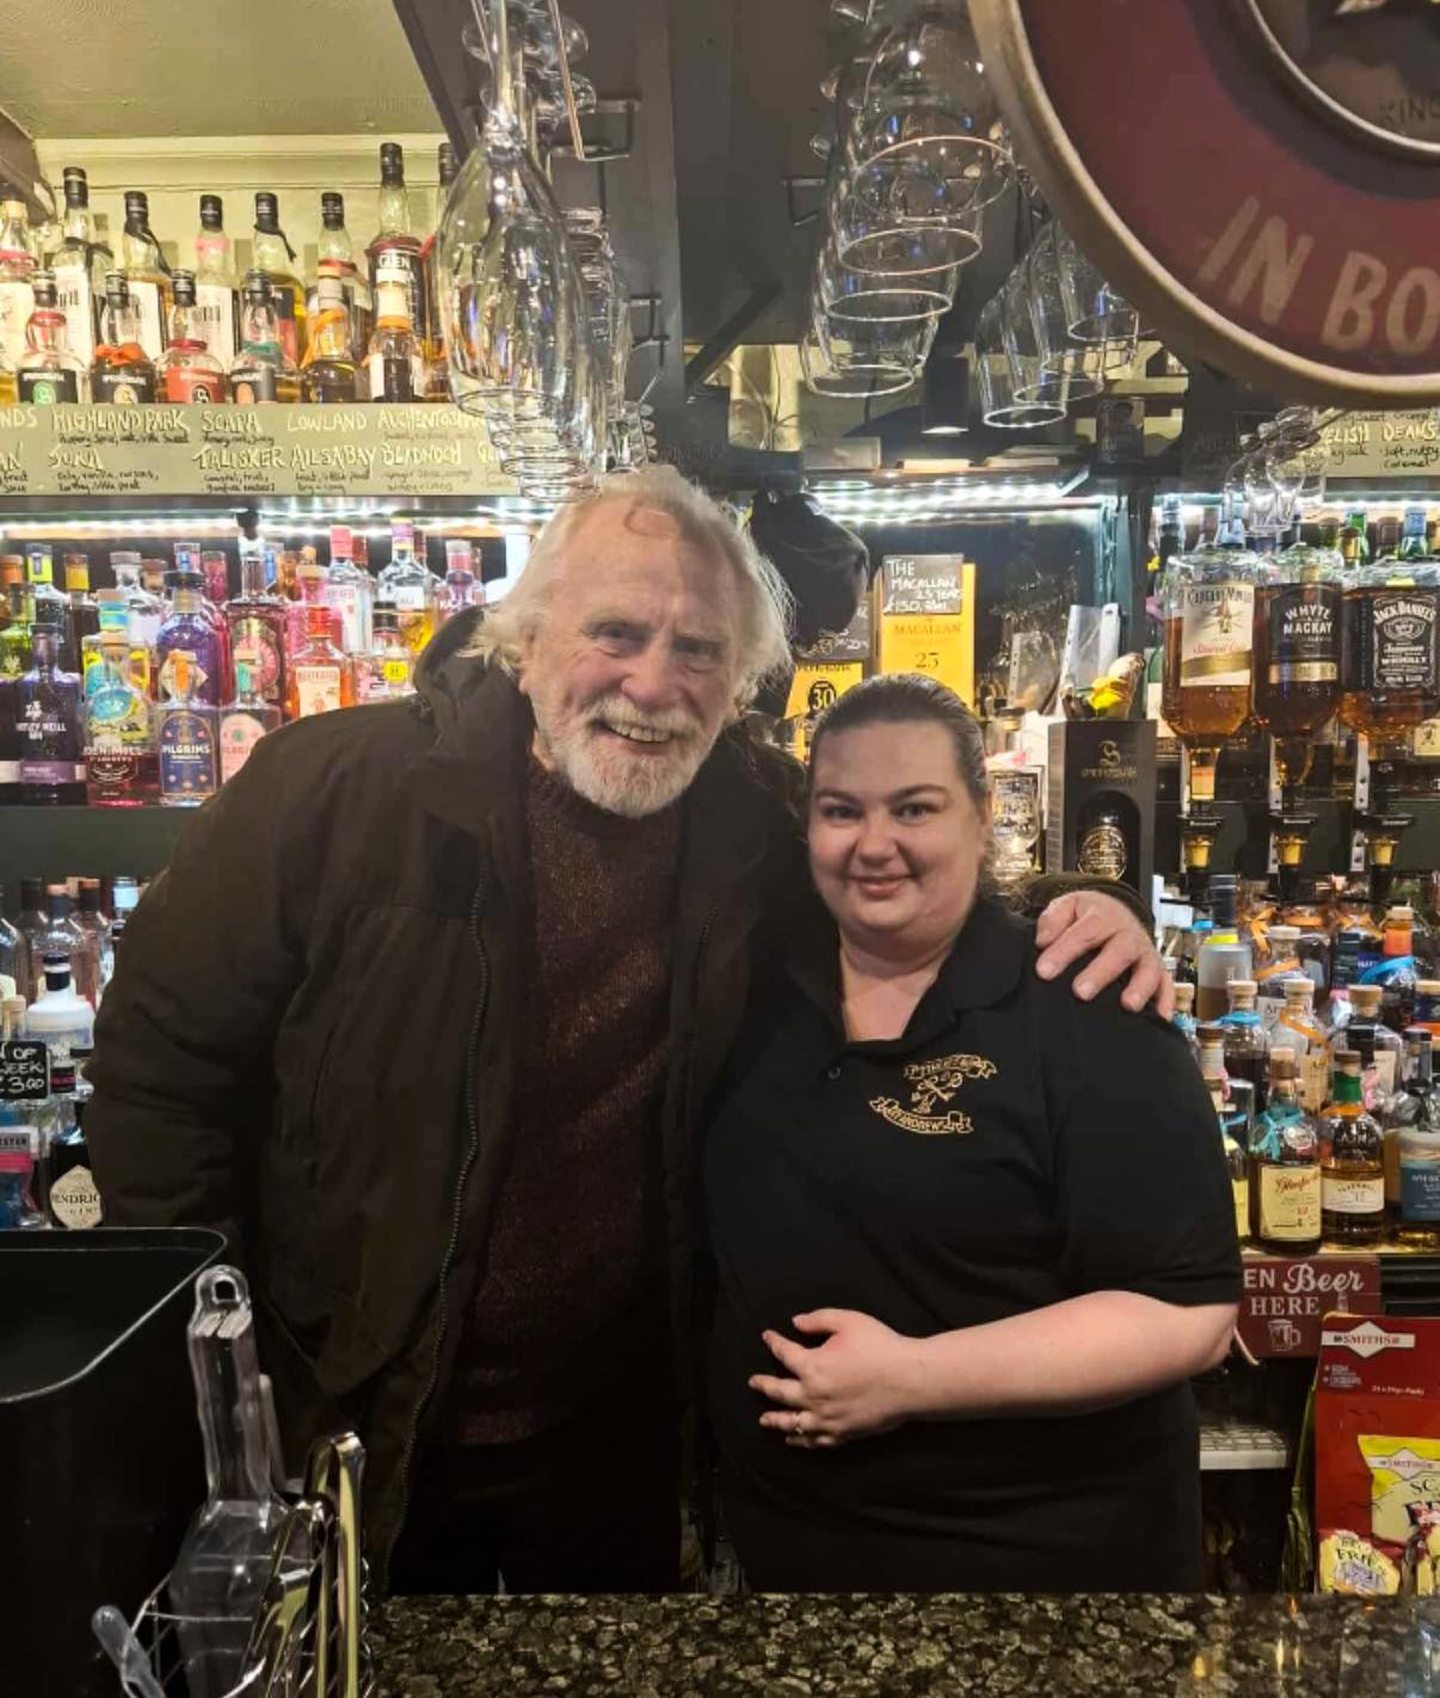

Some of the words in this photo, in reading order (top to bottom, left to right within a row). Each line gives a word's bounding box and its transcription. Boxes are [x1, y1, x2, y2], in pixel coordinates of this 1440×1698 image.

[1197, 195, 1315, 326] IN
[1321, 250, 1440, 354] BO
[52, 407, 138, 434] HIGHLAND
[143, 407, 190, 434] PARK
[201, 410, 262, 434] SCAPA
[287, 410, 368, 432] LOWLAND
[49, 444, 105, 472] JURA
[192, 443, 286, 471] TALISKER
[381, 442, 462, 465] BLADNOCH
[886, 559, 916, 577] THE
[1285, 604, 1332, 621] WHYTE
[1283, 621, 1333, 636] MACKAY
[915, 652, 940, 669] 25
[812, 687, 836, 710] 30
[161, 744, 211, 755] PILGRIMS
[13, 1047, 37, 1060] OF
[1243, 1269, 1275, 1289] EN
[1283, 1262, 1365, 1294] Beer
[1250, 1295, 1320, 1317] HERE
